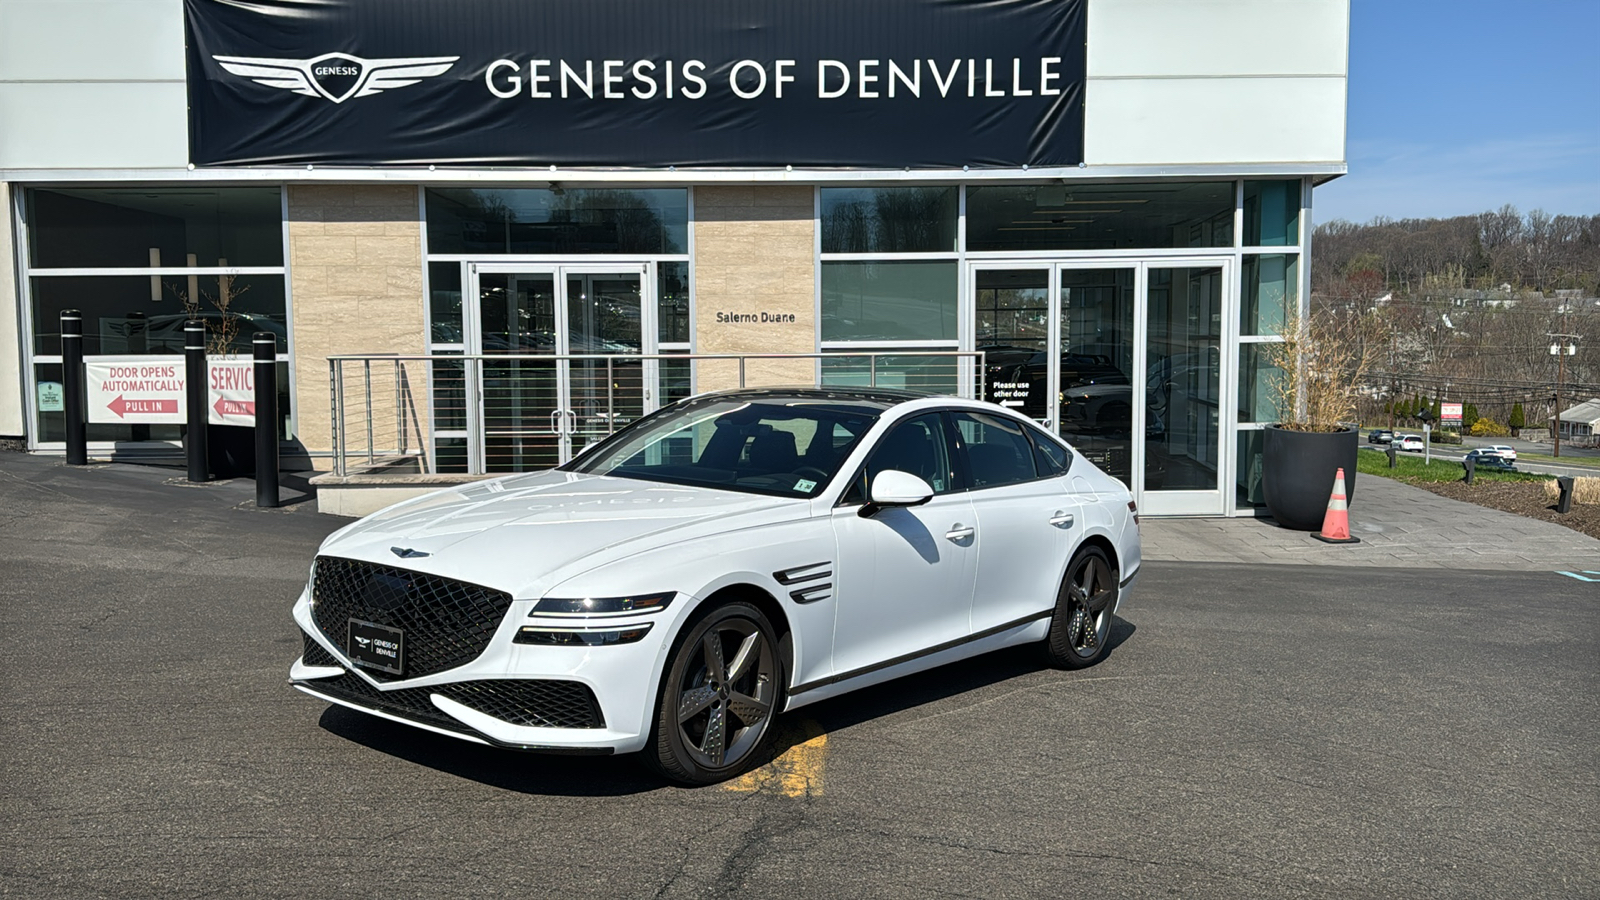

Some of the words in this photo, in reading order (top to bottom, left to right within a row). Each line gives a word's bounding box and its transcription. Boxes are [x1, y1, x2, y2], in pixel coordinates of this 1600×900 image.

[315, 66, 358, 76] GENESIS
[485, 59, 707, 100] GENESIS
[729, 59, 796, 99] OF
[818, 57, 1062, 98] DENVILLE
[716, 312, 758, 322] Salerno
[761, 312, 795, 322] Duane
[110, 367, 139, 378] DOOR
[140, 366, 176, 378] OPENS
[211, 366, 255, 391] SERVIC
[102, 380, 184, 392] AUTOMATICALLY
[125, 402, 149, 411] PULL
[152, 402, 162, 411] IN
[224, 402, 239, 413] PULL
